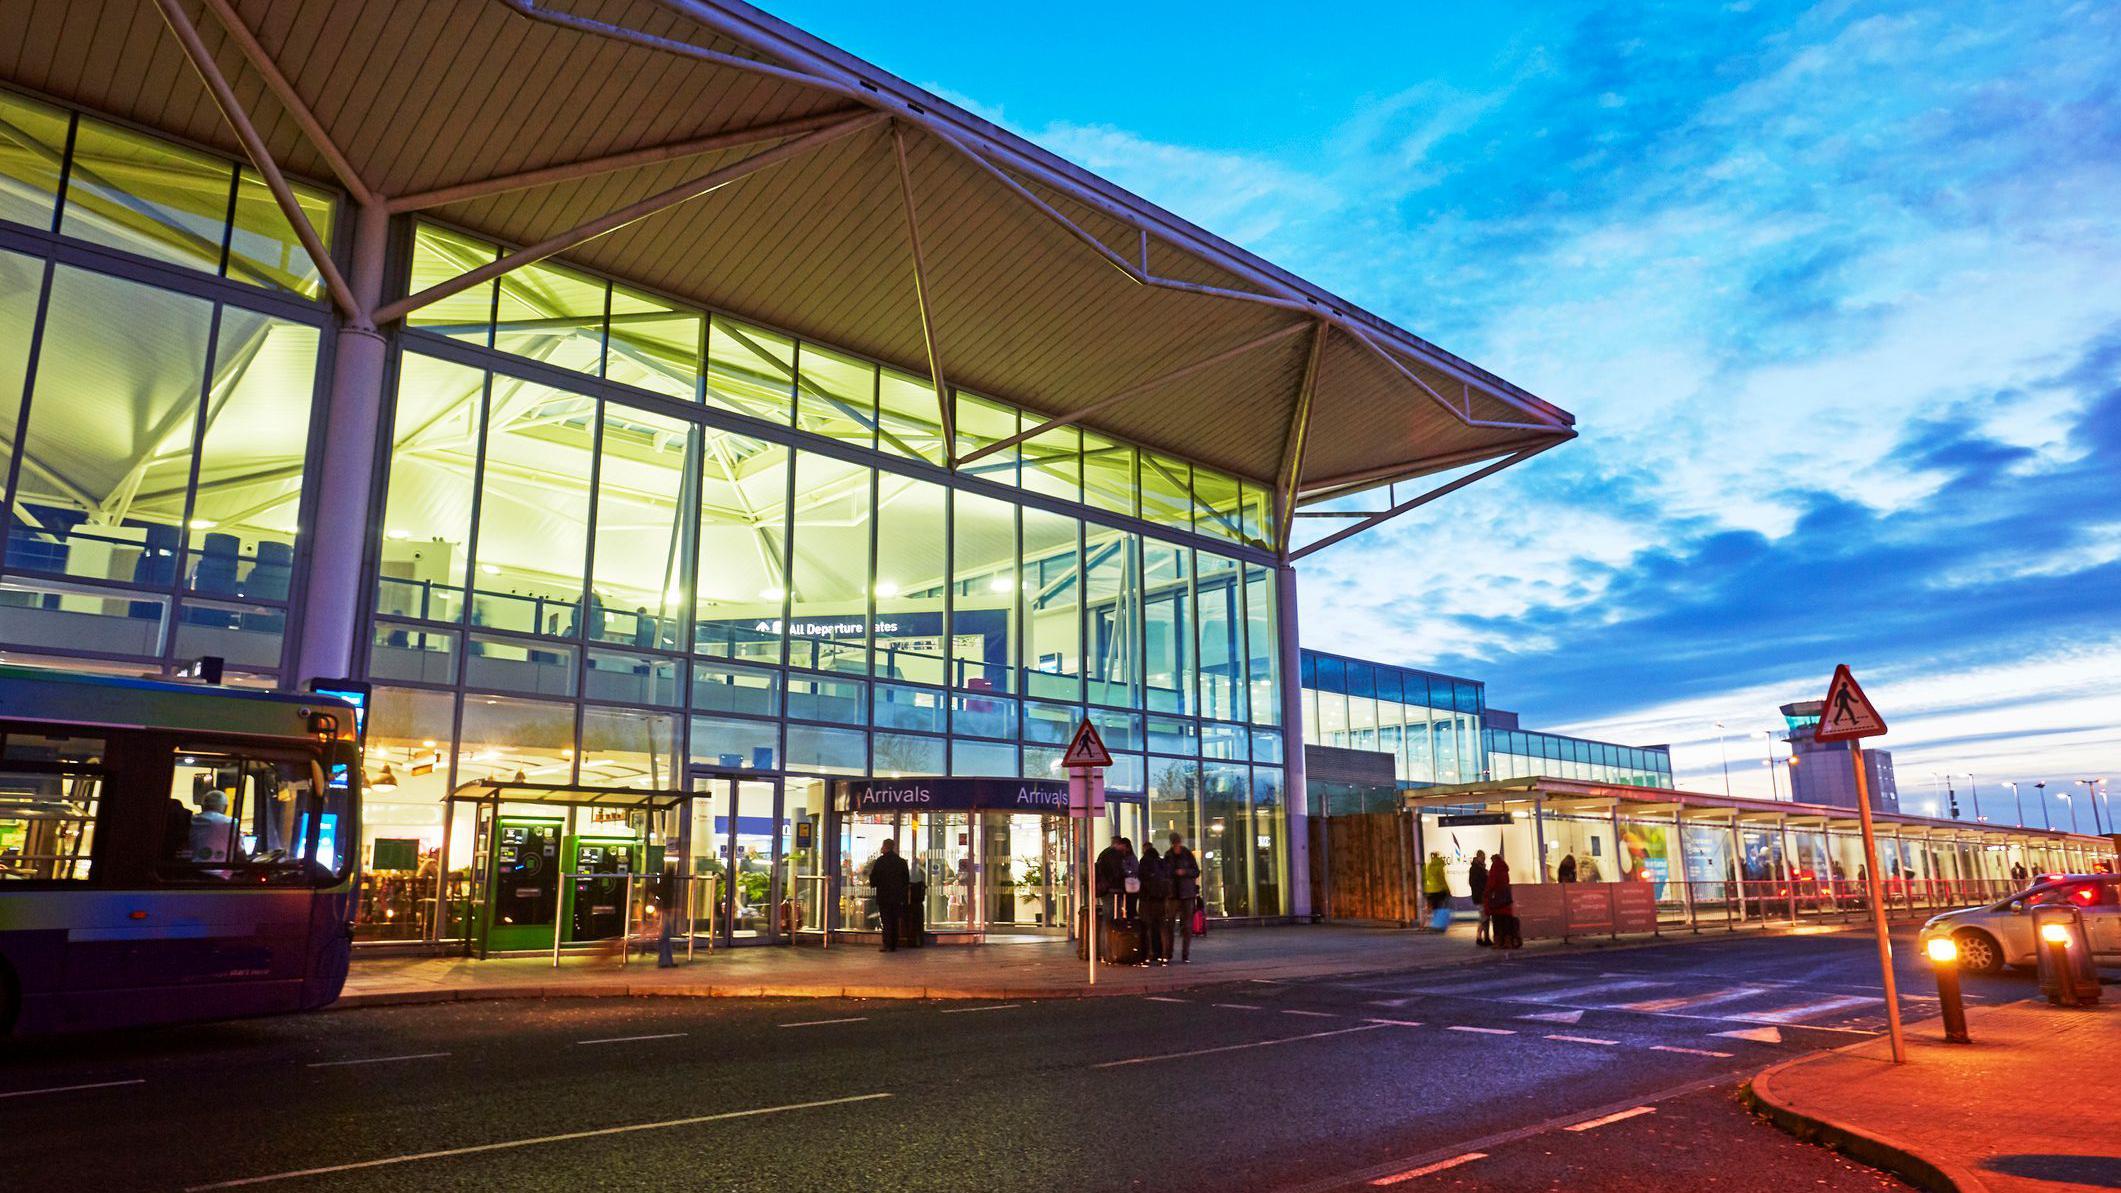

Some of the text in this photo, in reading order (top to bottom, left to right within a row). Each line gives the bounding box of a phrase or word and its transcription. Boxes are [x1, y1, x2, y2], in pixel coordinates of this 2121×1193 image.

[789, 621, 898, 637] All Departure ates
[863, 786, 930, 803] Arrivals
[1016, 787, 1069, 805] Arrivals
